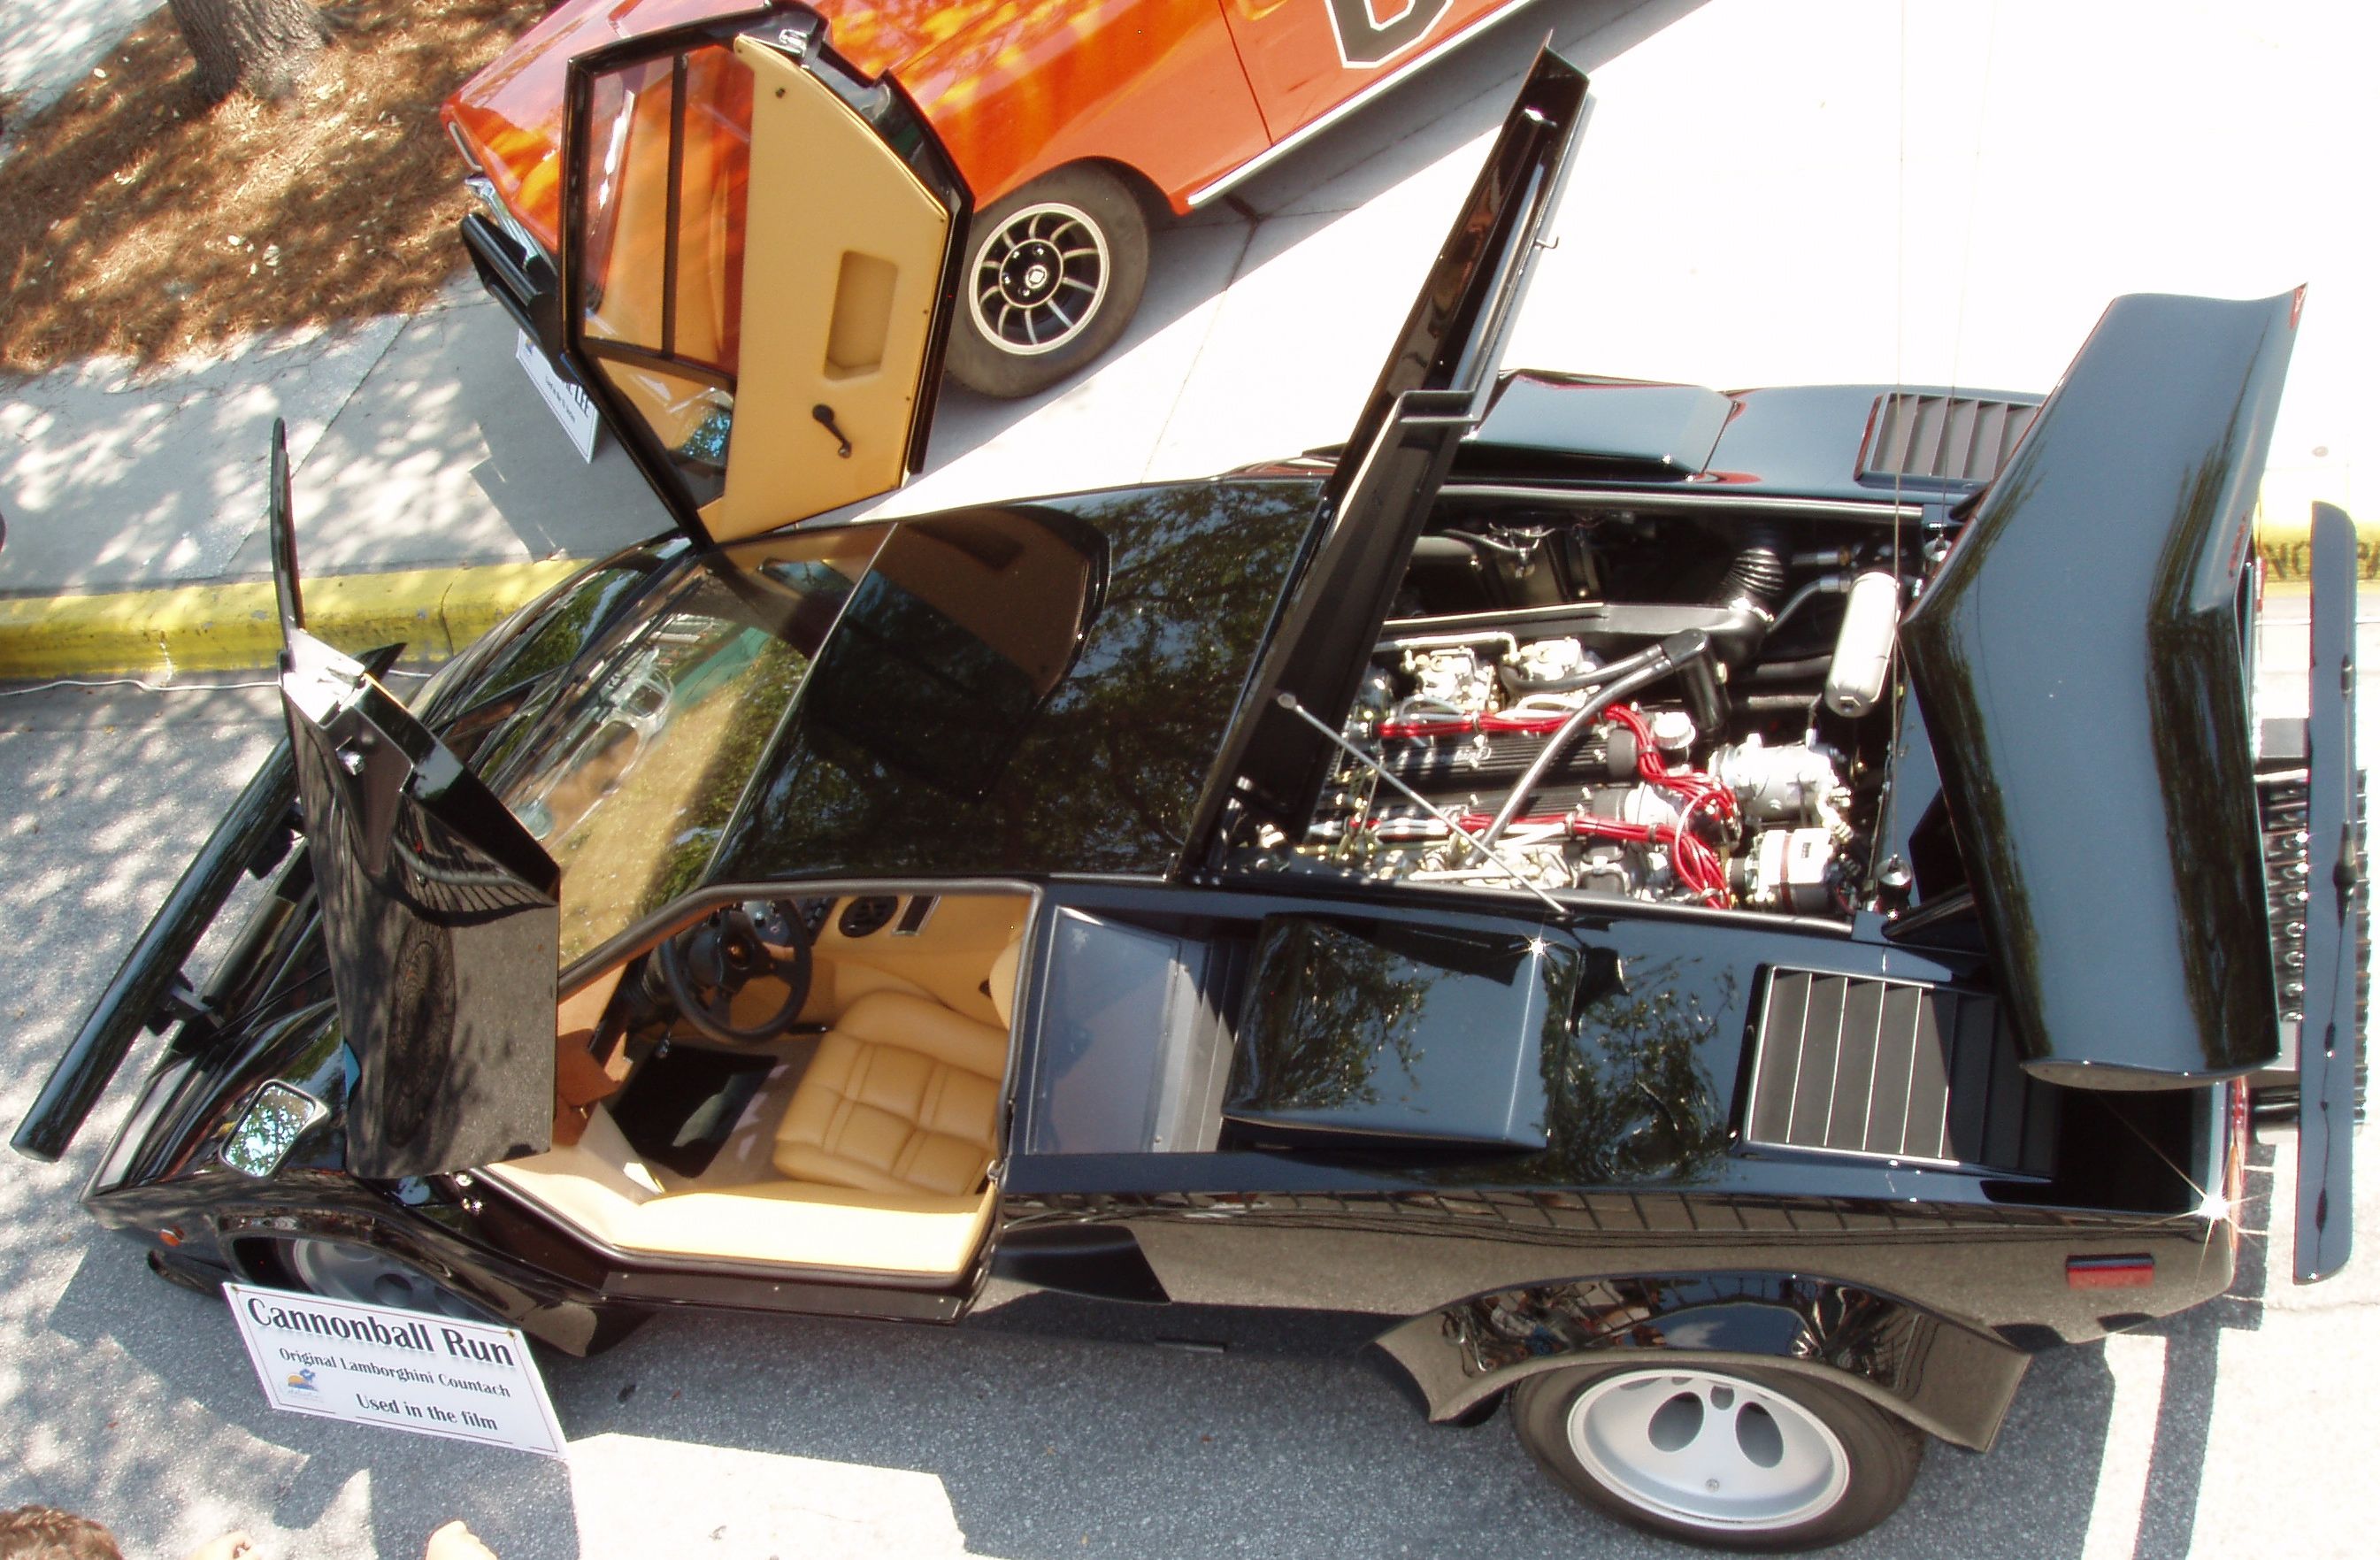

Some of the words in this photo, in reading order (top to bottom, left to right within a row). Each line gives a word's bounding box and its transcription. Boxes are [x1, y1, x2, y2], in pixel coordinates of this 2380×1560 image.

[248, 1297, 434, 1352] Cannonball
[441, 1327, 514, 1366] Run
[279, 1348, 337, 1368] Original
[341, 1357, 434, 1385] Lamborghini
[439, 1373, 511, 1398] Countach
[356, 1394, 400, 1415] Used
[405, 1398, 422, 1418] in
[426, 1405, 457, 1424] the
[461, 1410, 498, 1431] film
